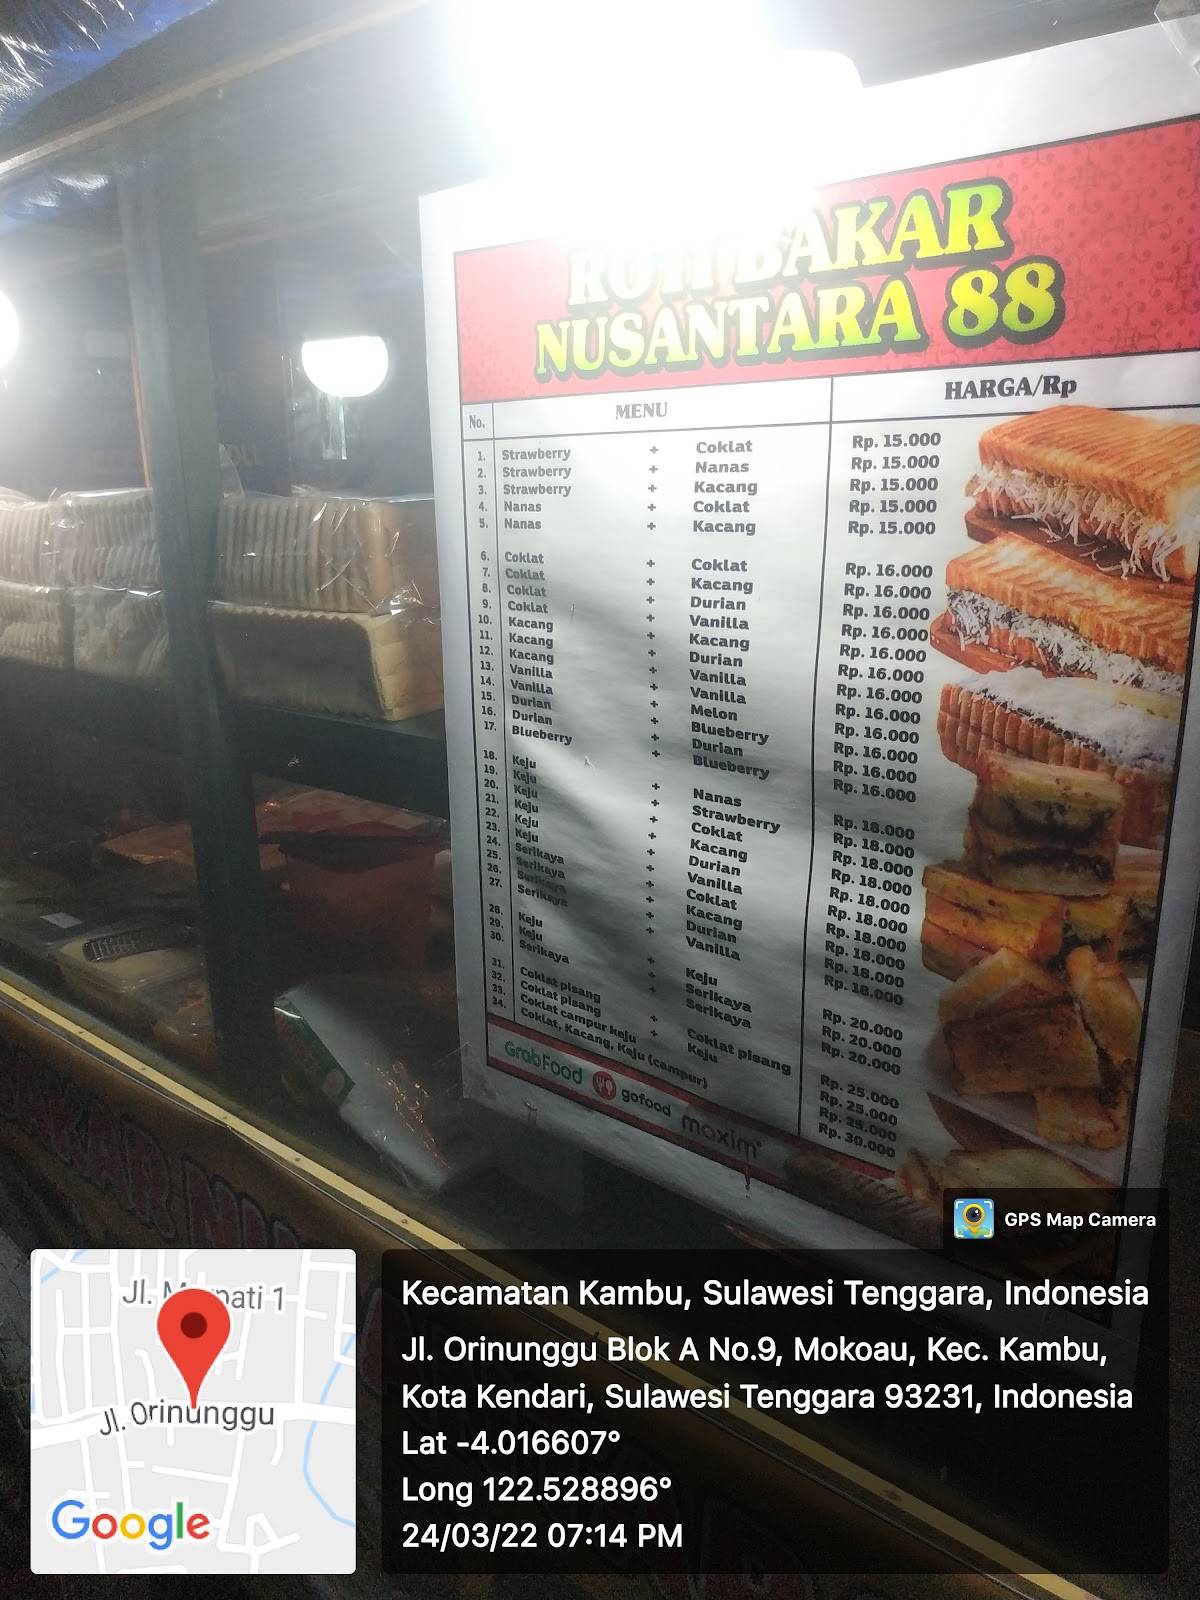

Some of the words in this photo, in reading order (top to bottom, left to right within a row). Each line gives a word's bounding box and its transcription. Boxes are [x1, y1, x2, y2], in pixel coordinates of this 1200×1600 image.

[536, 278, 925, 377] NUSANTARA
[946, 259, 1060, 342] 88
[468, 414, 486, 430] No.
[615, 402, 669, 421] MENU
[944, 374, 1078, 401] HARGA/Rp
[478, 452, 486, 462] 1.
[502, 448, 571, 462] Strawberry
[696, 440, 752, 454] Coklat
[852, 435, 878, 452] Rp.
[884, 432, 942, 448] 15.000
[478, 468, 486, 478] 2.
[502, 466, 572, 480] Strawberry
[696, 462, 750, 474] Nanas
[851, 456, 877, 473] Rp.
[882, 454, 940, 470] 15.000
[478, 484, 487, 495] 3.
[504, 484, 572, 498] Strawberry
[694, 481, 758, 496] Kacang
[850, 478, 876, 495] Rp.
[880, 477, 938, 492] 15.000
[478, 502, 488, 512] 4.
[504, 500, 542, 512] Nanas
[693, 500, 750, 513] Coklat
[849, 500, 875, 516] Rp.
[880, 499, 937, 513] 15.000
[480, 518, 488, 528] 5.
[504, 518, 542, 530] Nanas
[693, 520, 756, 536] Kacang
[848, 520, 874, 538] Rp.
[878, 521, 936, 535] 15.000
[480, 550, 490, 561] 6.
[504, 552, 544, 564] Coklat
[692, 558, 748, 572] Coklat
[845, 562, 871, 579] Rp.
[876, 564, 933, 578] 16.000
[482, 567, 490, 577] 7.
[505, 568, 545, 581] Coklat
[691, 577, 754, 595] Kacang
[844, 582, 870, 600] Rp.
[874, 584, 932, 600] 16.000
[482, 582, 491, 593] 8.
[506, 584, 547, 598] Coklat
[690, 596, 746, 611] Durian
[842, 603, 868, 620] Rp.
[872, 605, 930, 620] 16.000
[482, 598, 492, 609] 9.
[508, 600, 548, 614] Coklat
[689, 614, 750, 630] Vanilla
[841, 624, 867, 640] Rp.
[872, 626, 928, 642] 16.000
[478, 614, 492, 624] 10.
[508, 616, 554, 633] Kacang
[689, 632, 750, 652] Kacang
[840, 644, 865, 660] Rp.
[869, 646, 926, 662] 16.000
[480, 645, 494, 656] 12.
[509, 648, 554, 666] Kacang
[689, 668, 747, 686] Vanilla
[836, 683, 862, 700] Rp.
[866, 686, 923, 704] 16.000
[480, 675, 495, 686] 14.
[510, 678, 554, 696] Vanilla
[690, 704, 738, 722] Melon
[834, 722, 860, 739] Rp.
[864, 726, 920, 744] 16.000
[511, 694, 552, 710] Durian
[691, 721, 770, 746] Blueberry
[834, 741, 858, 758] Rp.
[862, 746, 918, 764] 16.000
[512, 754, 536, 770] Keju
[693, 788, 742, 807] Nanas
[834, 813, 858, 831] Rp.
[862, 819, 916, 840] 18.000
[514, 798, 538, 814] Keju
[690, 838, 748, 863] Kacang
[831, 868, 855, 885] Rp.
[859, 874, 912, 896] 18.000
[514, 813, 538, 828] Keju
[688, 854, 740, 876] Durian
[829, 886, 853, 904] Rp.
[857, 893, 910, 916] 18.000
[518, 912, 543, 928] Keju
[686, 967, 718, 986] Keju
[822, 1008, 846, 1026] Rp.
[849, 1016, 903, 1041] 20.000
[520, 940, 570, 966] Serikaya
[686, 998, 752, 1030] Serikaya
[821, 1040, 844, 1059] Rp.
[848, 1050, 901, 1076] 20.000
[520, 966, 558, 986] Coklat
[560, 982, 602, 1004] pisang
[687, 1028, 735, 1055] Coklat
[738, 1048, 792, 1076] pisang
[820, 1074, 843, 1091] Rp.
[847, 1083, 900, 1109] 25.000
[504, 1040, 583, 1085] GrabFood
[621, 1087, 672, 1117] gofood
[520, 1006, 562, 1032] Coklat,
[564, 1023, 614, 1051] Kacang,
[618, 1042, 646, 1061] Keju
[648, 1054, 708, 1090] (campur)
[818, 1122, 842, 1140] Rp.
[844, 1132, 896, 1158] 30.000
